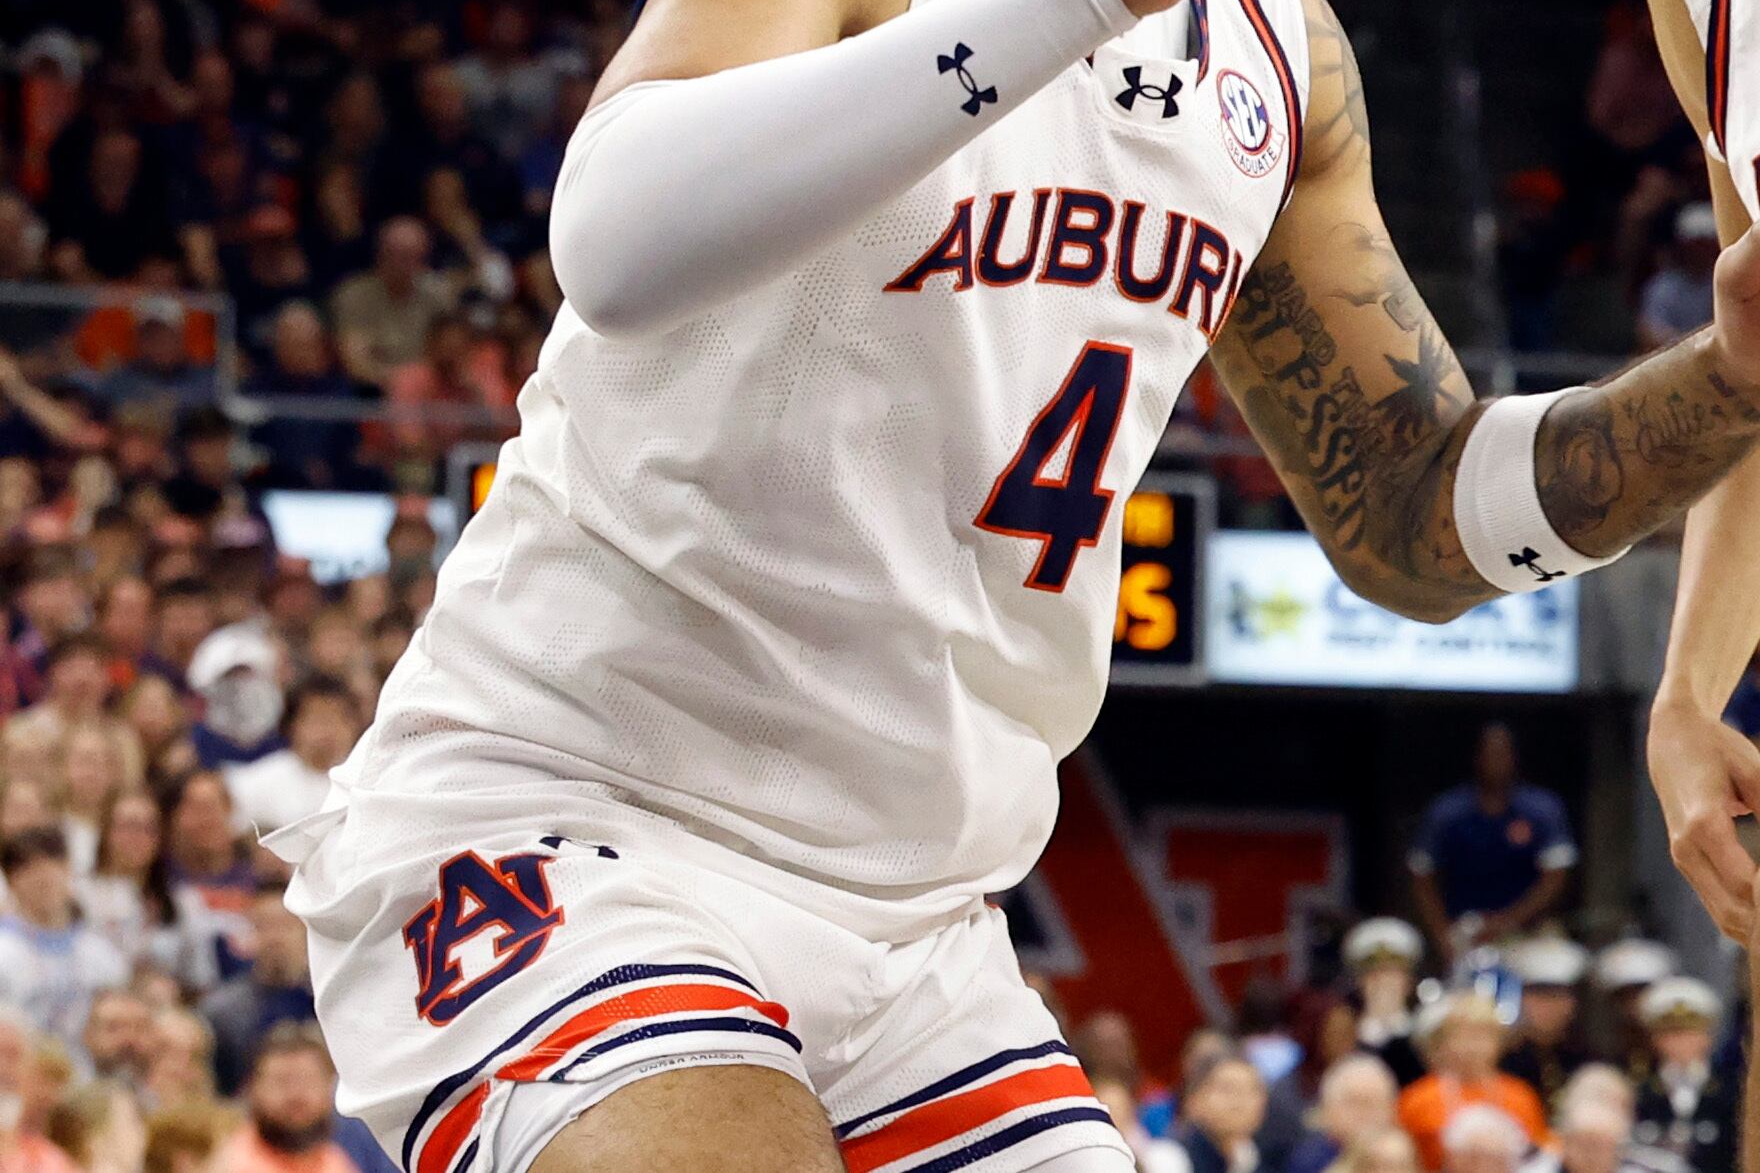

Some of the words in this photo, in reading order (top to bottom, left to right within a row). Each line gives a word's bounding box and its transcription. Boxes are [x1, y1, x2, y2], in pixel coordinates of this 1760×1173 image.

[1221, 73, 1268, 148] SEC
[972, 339, 1133, 594] 4
[639, 1057, 686, 1074] UNDER
[690, 1053, 746, 1062] ARMOUR
